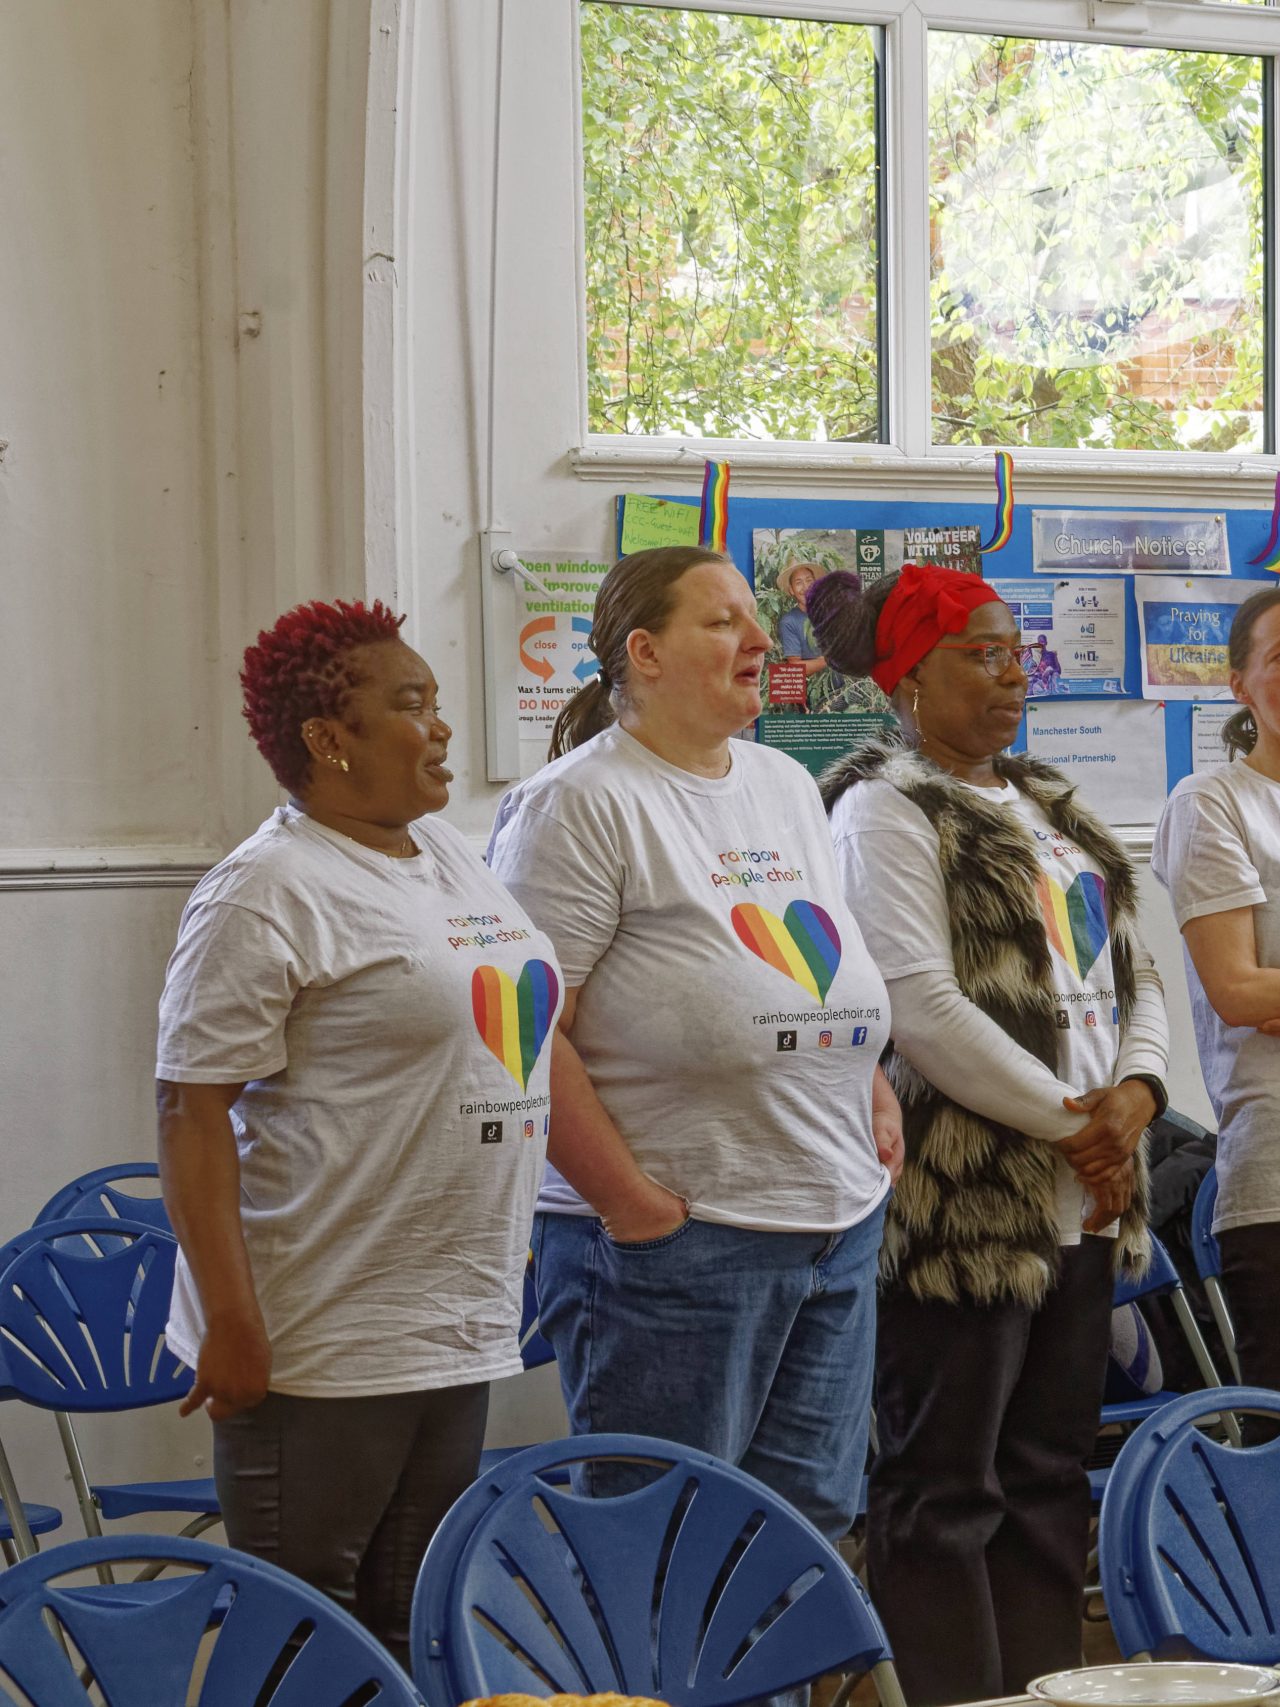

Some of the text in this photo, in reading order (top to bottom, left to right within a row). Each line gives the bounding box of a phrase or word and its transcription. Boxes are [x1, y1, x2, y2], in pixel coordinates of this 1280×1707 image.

[627, 497, 658, 514] FREE
[907, 530, 976, 544] VOLUNTEER
[907, 543, 961, 556] WITH US
[1055, 534, 1207, 556] Church Notices
[556, 560, 609, 573] window
[860, 572, 882, 580] THAN
[1170, 608, 1221, 627] Praying
[1189, 626, 1207, 641] for
[534, 640, 589, 652] close ope
[1169, 647, 1226, 664] Ukraine
[518, 686, 533, 694] Max
[543, 686, 564, 694] turns
[566, 686, 581, 694] eith
[519, 700, 566, 710] DO NOT
[1032, 726, 1102, 736] Manchester South
[1072, 754, 1117, 764] Partnership
[718, 848, 780, 865] rainbow
[1053, 844, 1081, 857] cho
[711, 867, 803, 888] people choir
[447, 914, 502, 928] rainbow
[447, 928, 531, 950] people choir
[753, 1008, 880, 1025] rainbowpeoplechoir.org
